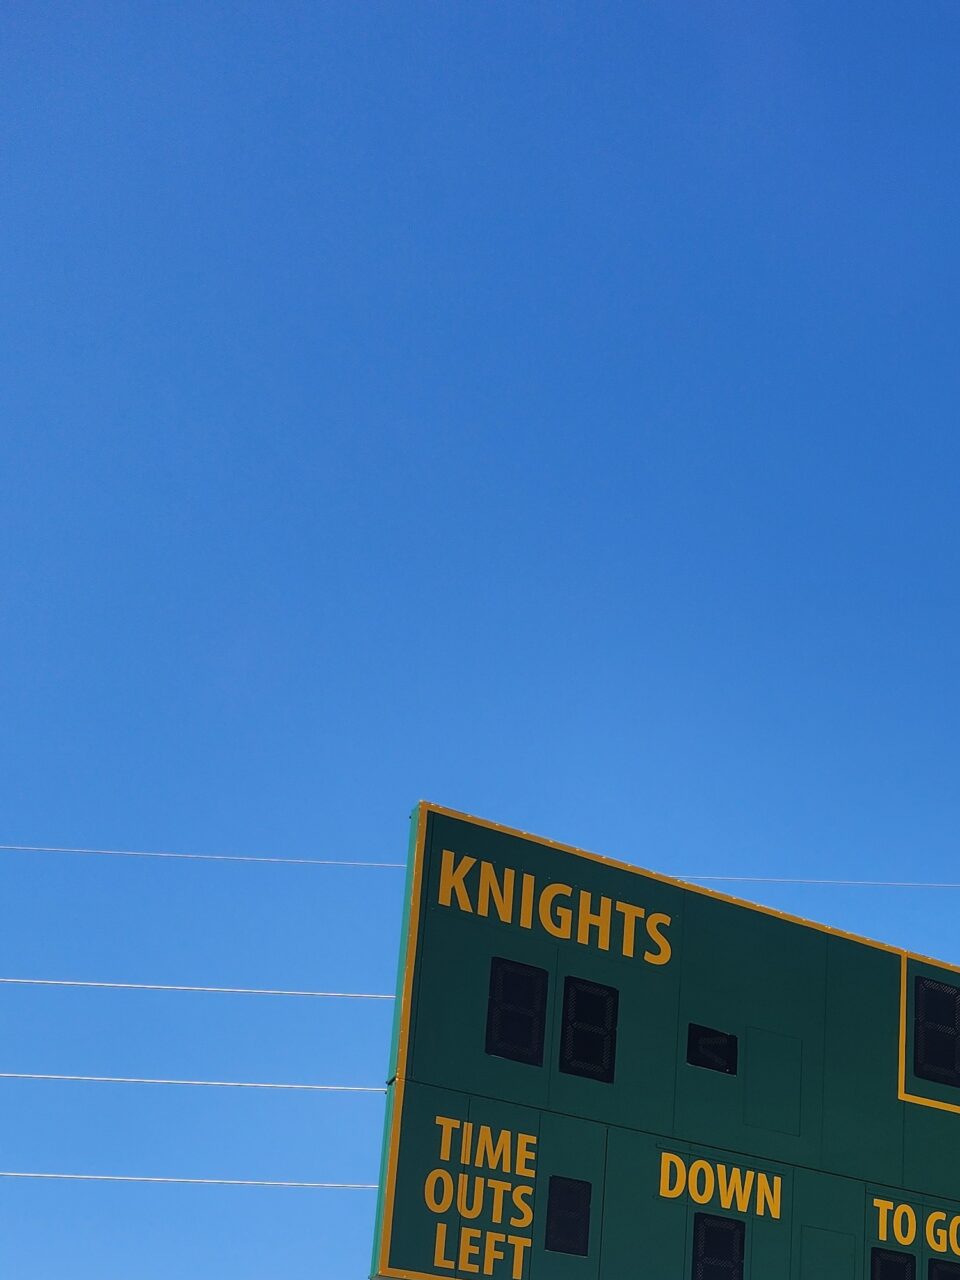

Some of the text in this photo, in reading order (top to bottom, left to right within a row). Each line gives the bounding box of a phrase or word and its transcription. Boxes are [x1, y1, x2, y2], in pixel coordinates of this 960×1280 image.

[438, 850, 673, 966] KNIGHTS
[435, 1116, 537, 1179] TIME
[424, 1168, 534, 1228] OUTS
[659, 1152, 782, 1220] DOWN
[433, 1222, 532, 1280] LEFT
[872, 1197, 917, 1246] TO
